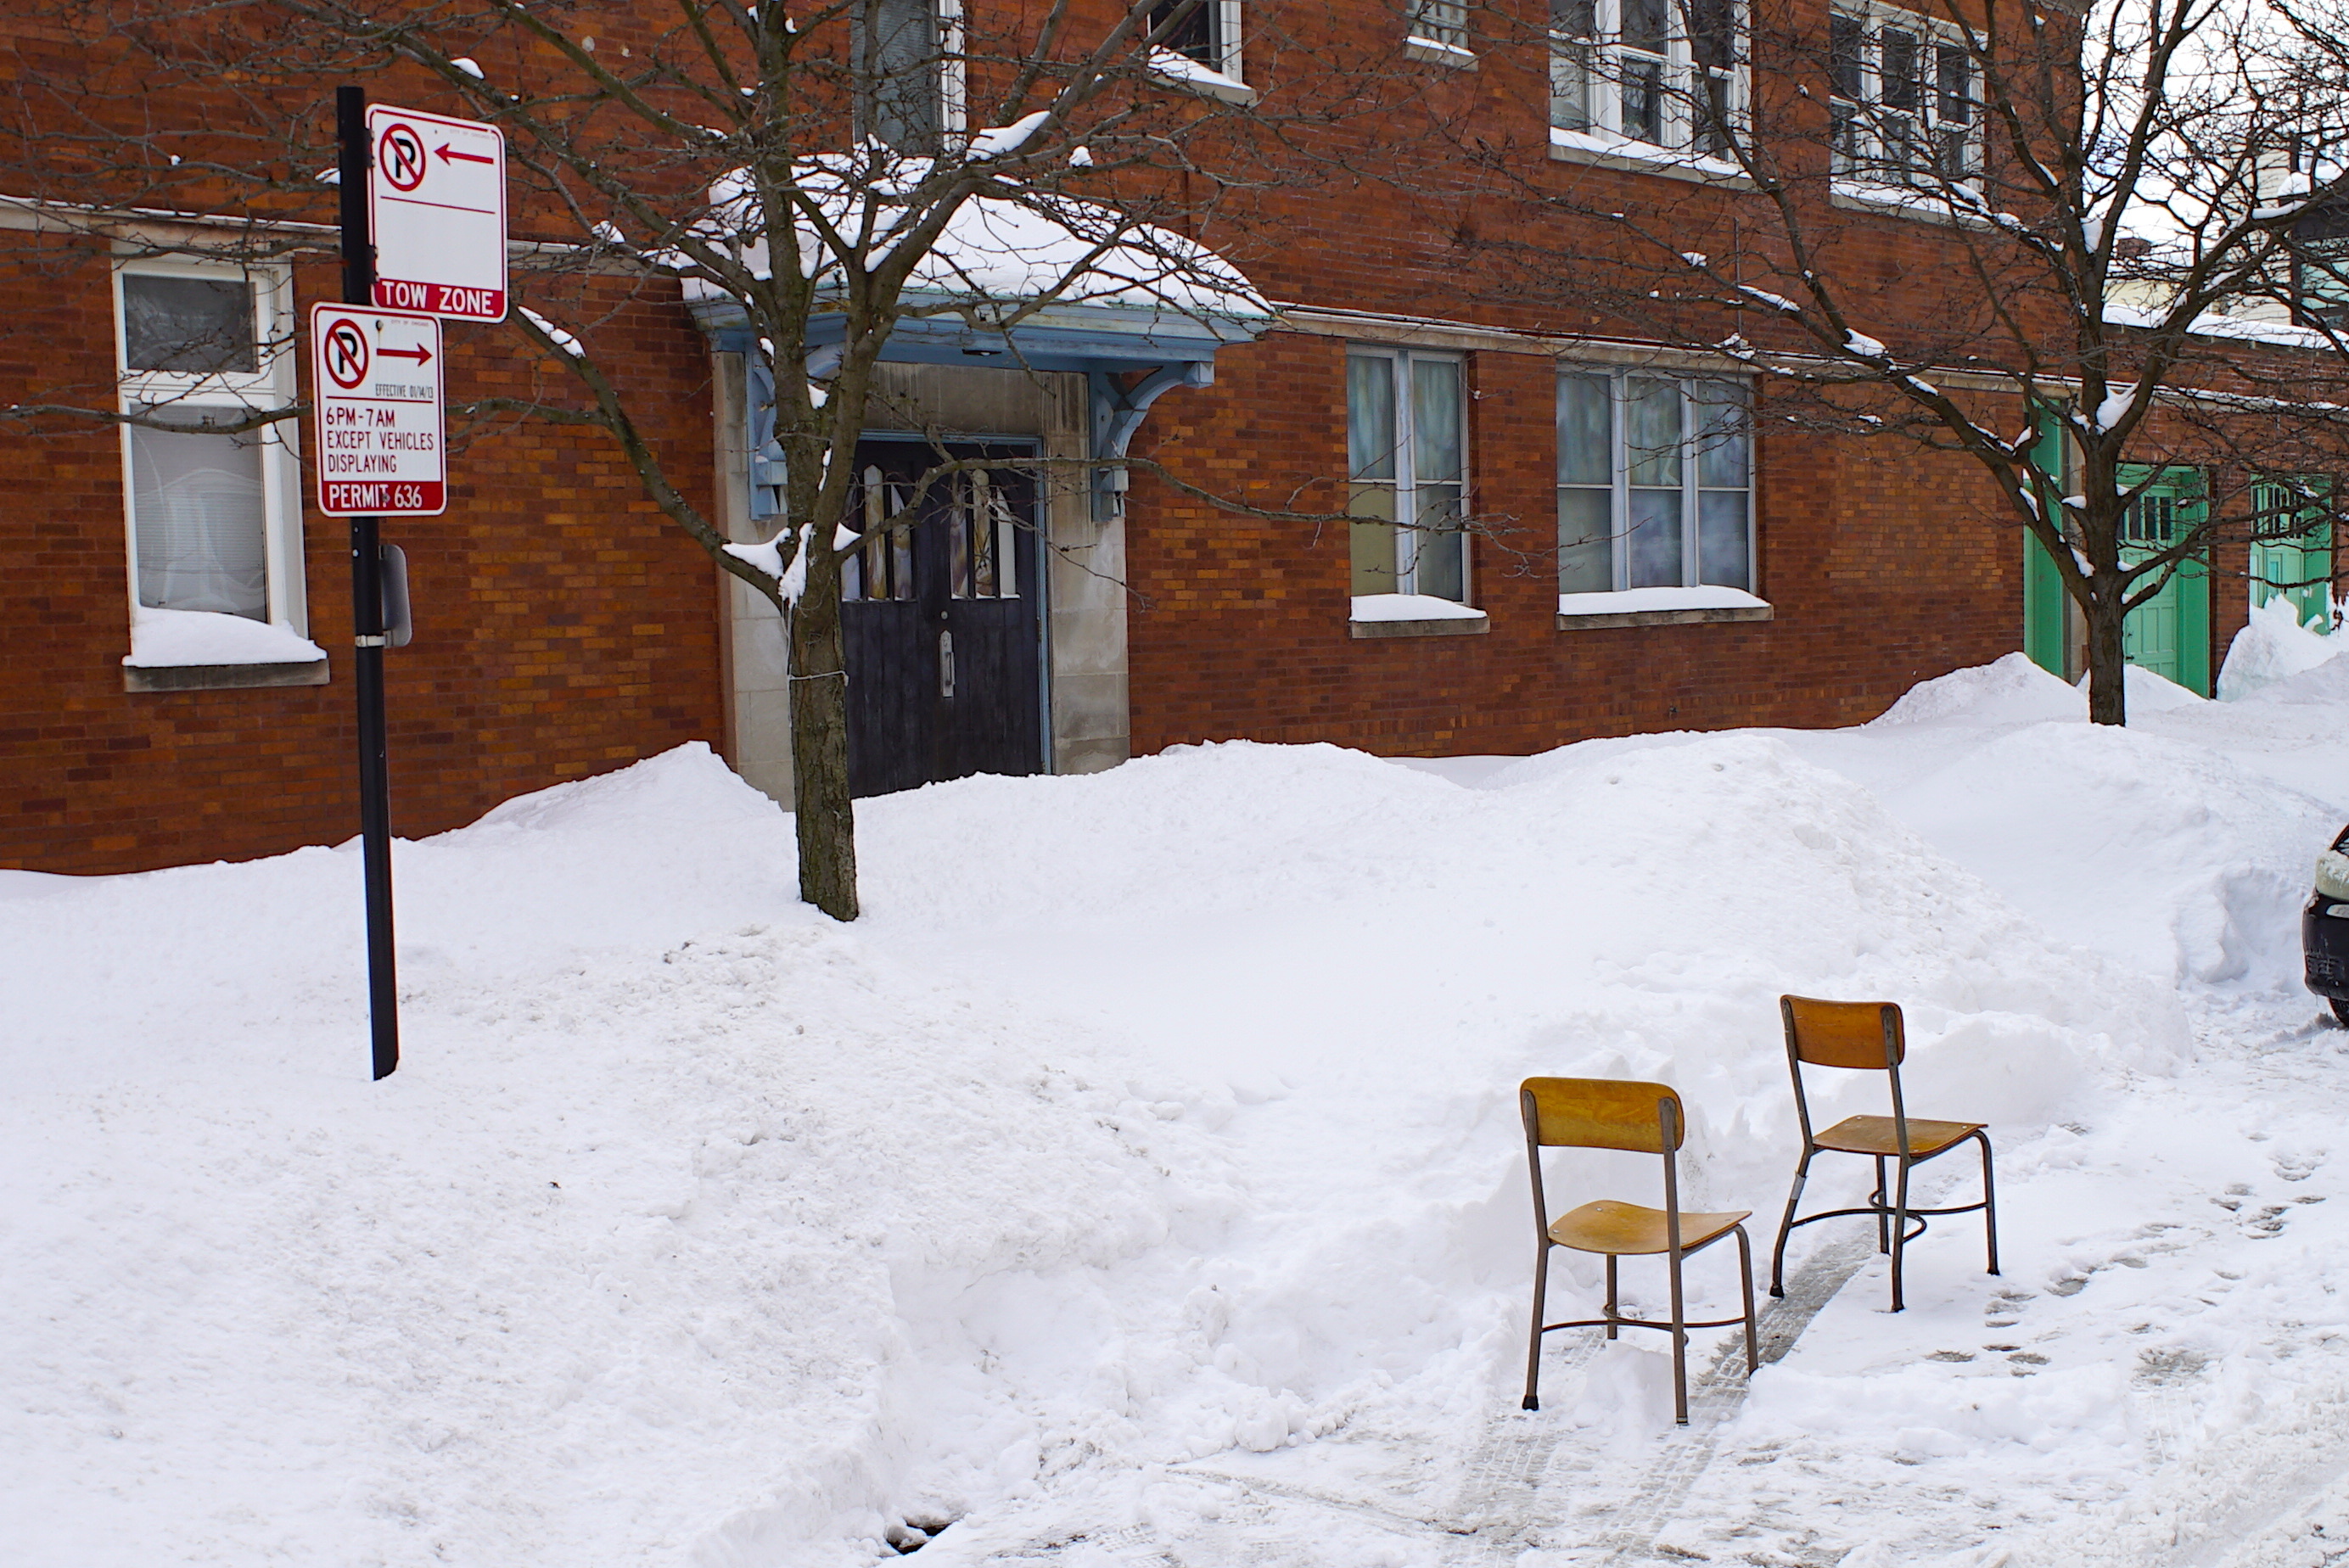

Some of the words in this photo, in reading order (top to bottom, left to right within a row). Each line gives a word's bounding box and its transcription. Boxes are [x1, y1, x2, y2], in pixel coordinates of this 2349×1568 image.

[382, 281, 427, 309] TOW
[439, 287, 494, 315] ZONE
[375, 384, 406, 397] EFFECTIVE
[327, 430, 371, 449] EXCEPT
[379, 432, 434, 451] VEHICLES
[328, 454, 397, 473] DISPLAYING
[328, 484, 389, 508] PERMIT
[394, 484, 423, 508] 636
